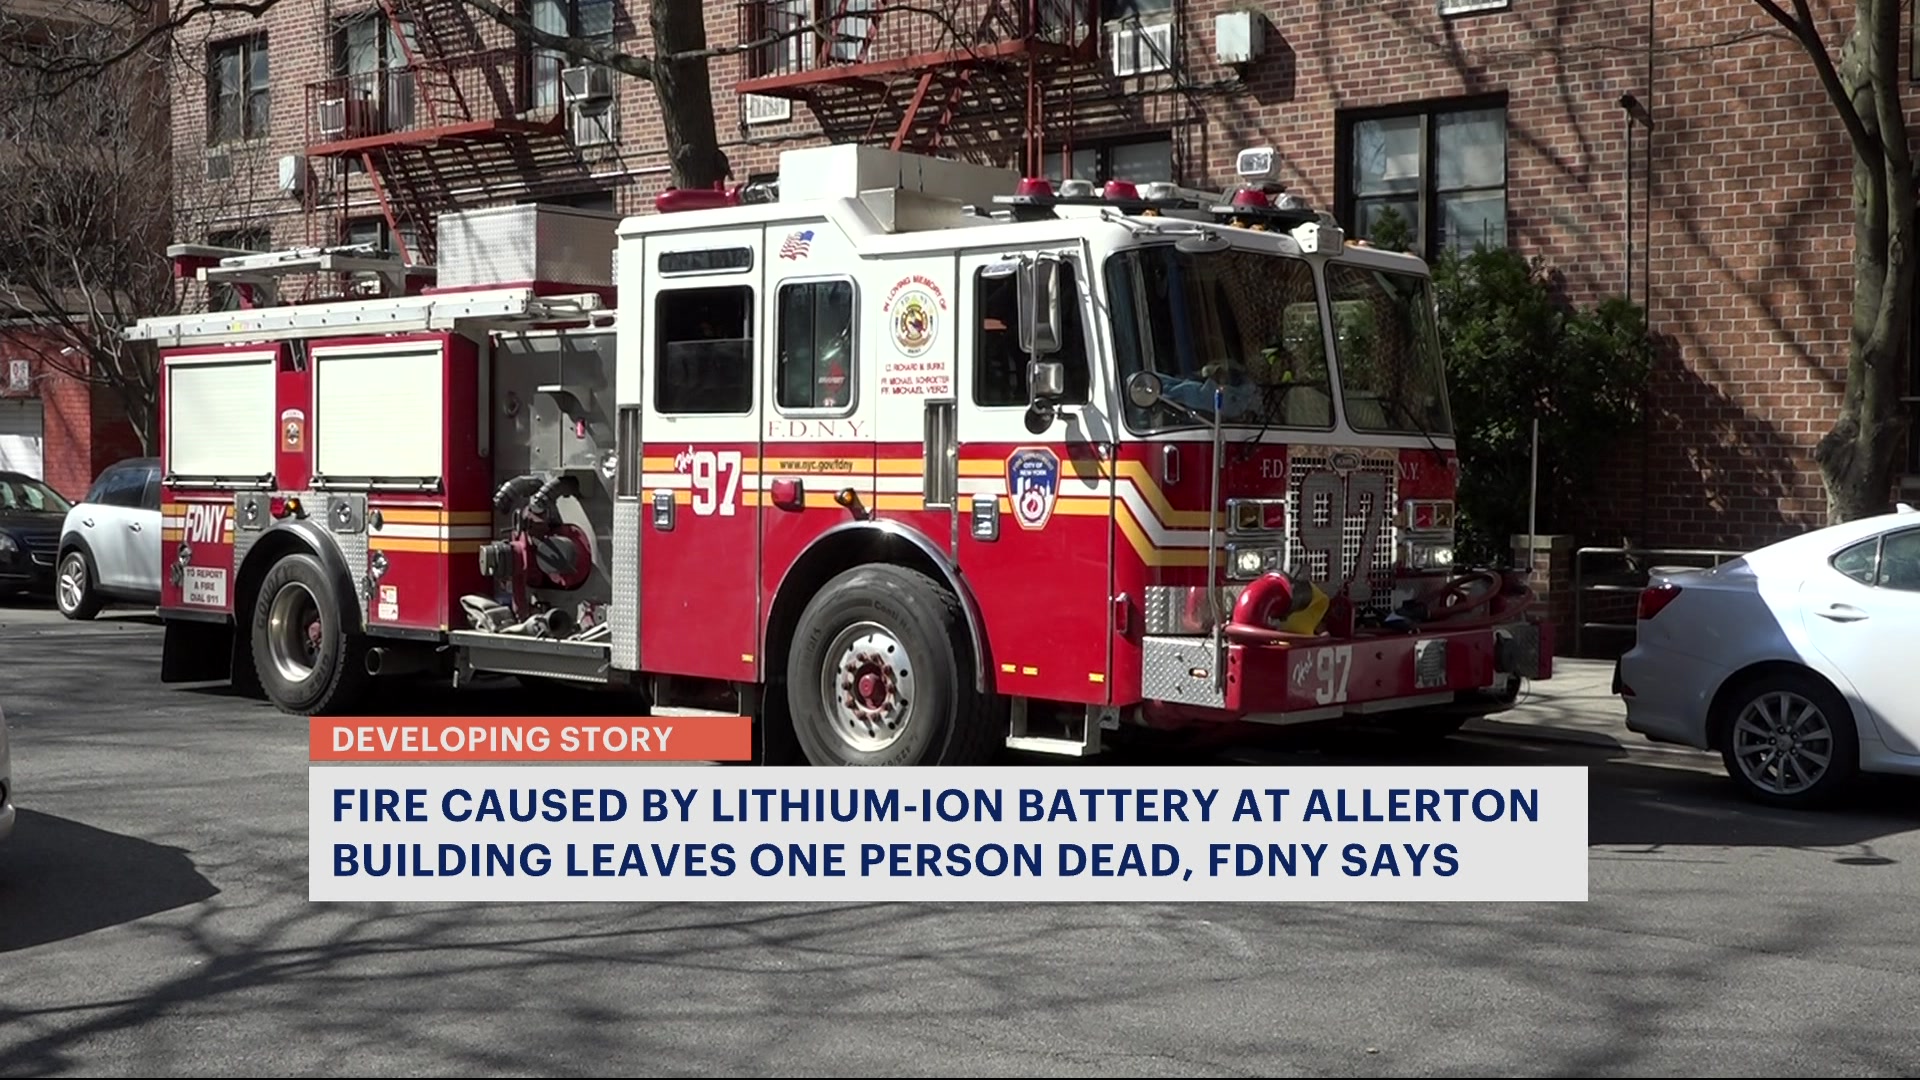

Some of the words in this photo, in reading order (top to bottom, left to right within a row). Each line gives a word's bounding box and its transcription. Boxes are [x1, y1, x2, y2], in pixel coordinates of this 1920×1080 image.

[887, 276, 911, 301] LOVING
[913, 275, 942, 297] MEMORY
[889, 377, 913, 385] MICHAEL
[892, 386, 924, 395] MICHAEL
[767, 420, 869, 438] F.D.N.Y.
[779, 458, 854, 474] www.nyc.gov/fdny
[692, 451, 742, 516] 97
[183, 505, 227, 543] FDNY
[186, 568, 196, 577] TO
[196, 569, 223, 579] REPORT
[194, 581, 201, 590] A
[201, 582, 215, 591] FIRE
[190, 593, 205, 603] DIAL
[206, 594, 219, 604] 911
[1316, 646, 1352, 705] 97
